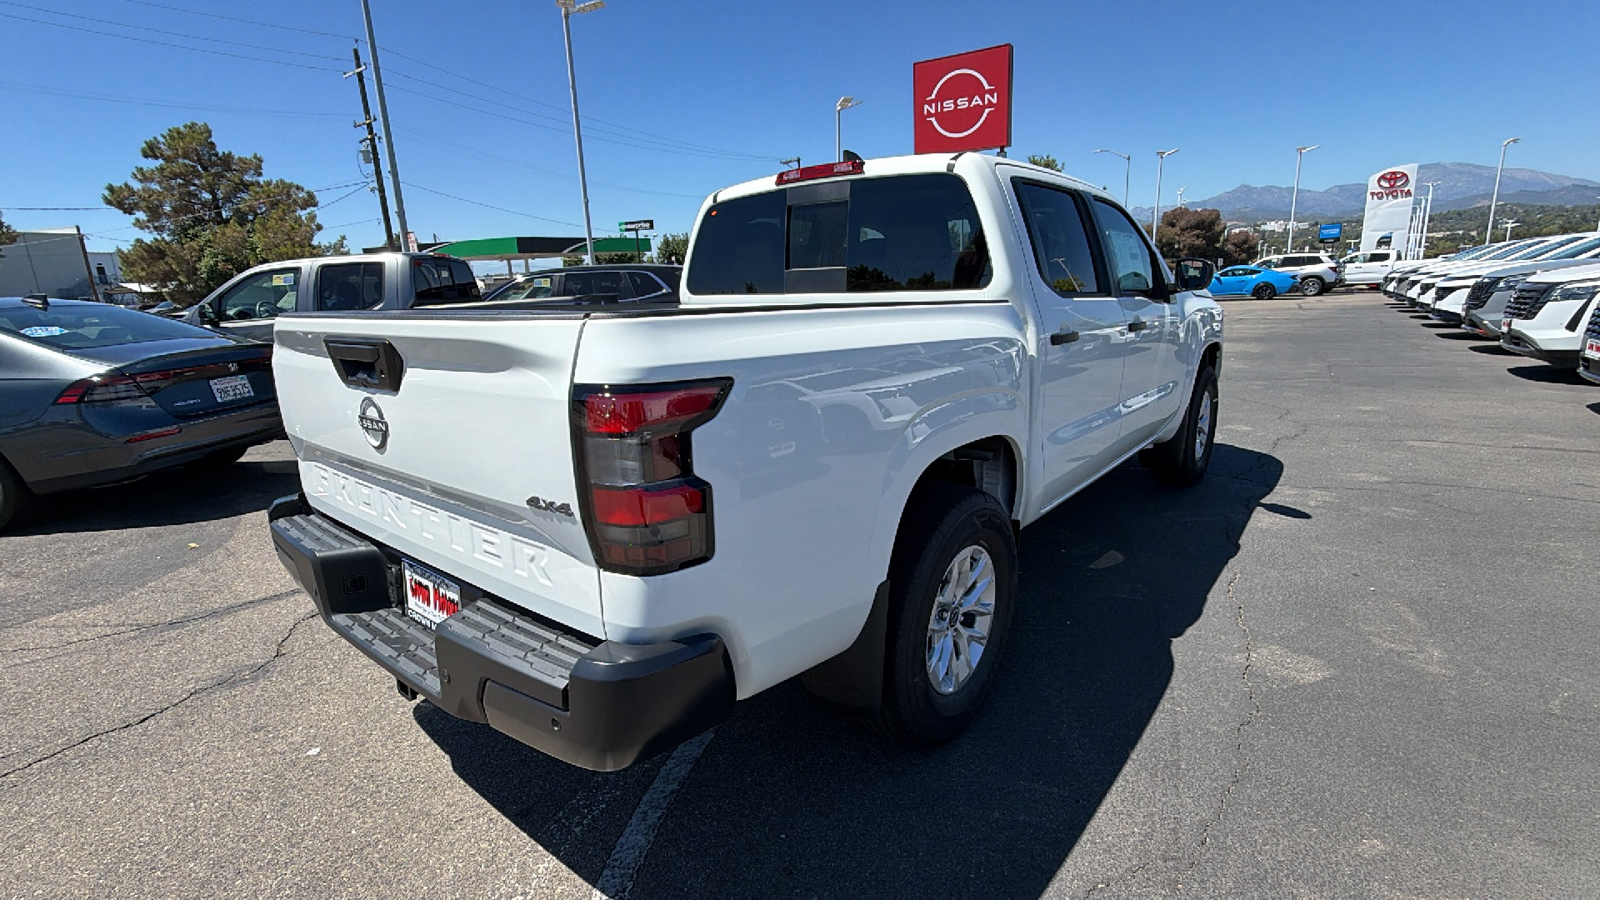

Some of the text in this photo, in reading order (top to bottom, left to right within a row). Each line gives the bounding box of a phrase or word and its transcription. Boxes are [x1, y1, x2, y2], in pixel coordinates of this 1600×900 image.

[923, 92, 997, 115] NISSAN
[1370, 188, 1412, 200] TOYOTA
[621, 221, 650, 229] enterprise
[314, 463, 553, 588] FRONTIER
